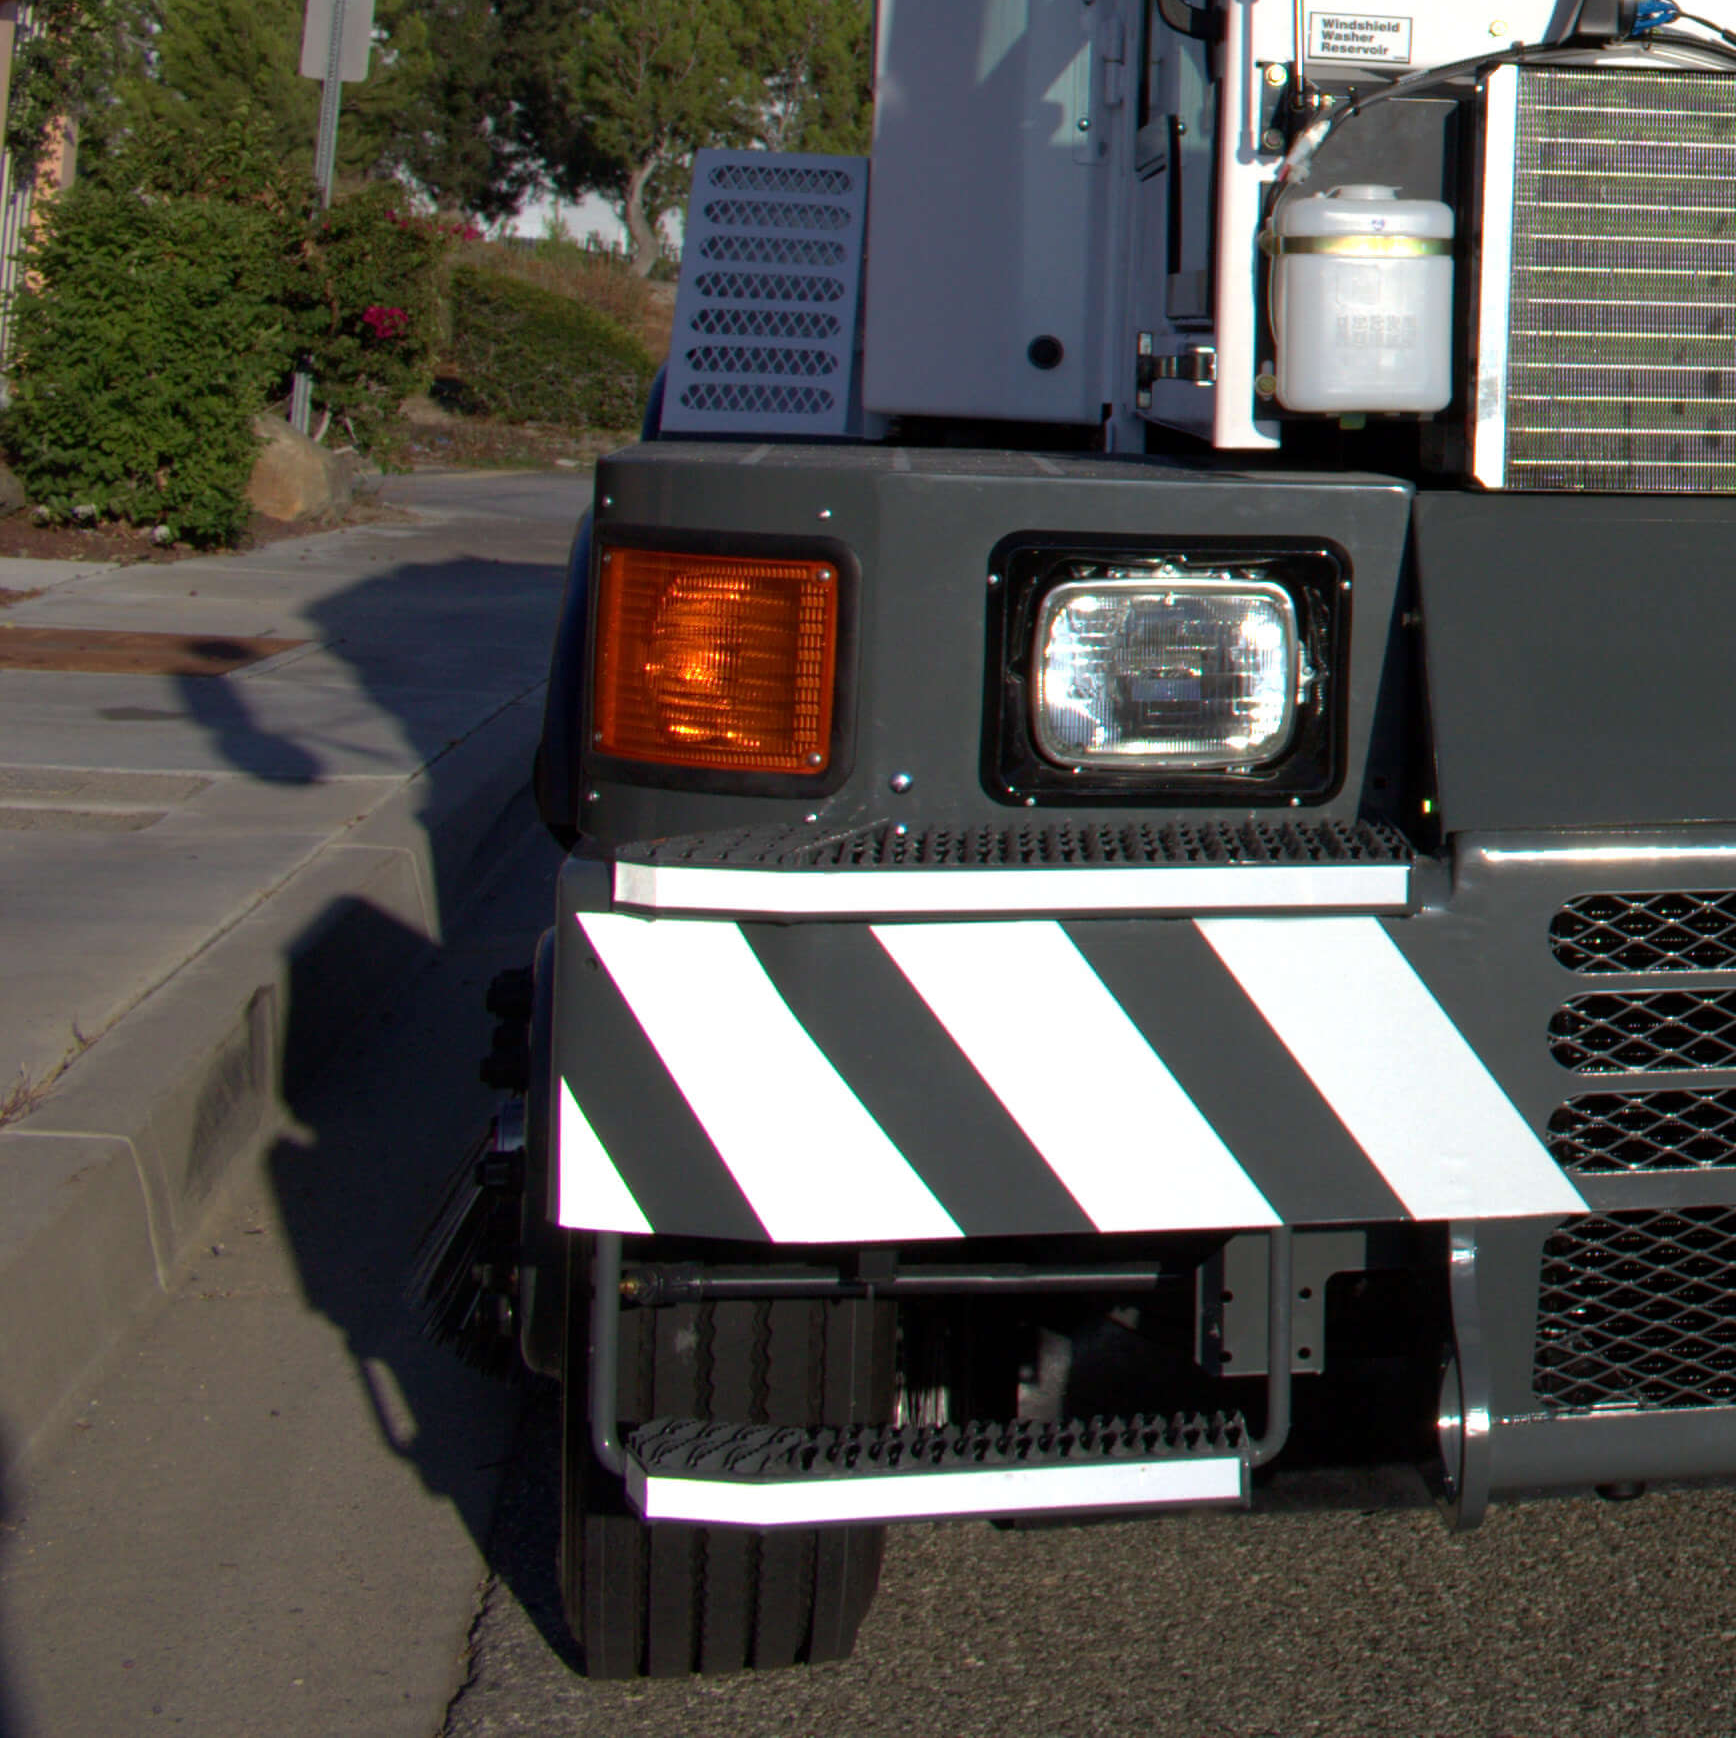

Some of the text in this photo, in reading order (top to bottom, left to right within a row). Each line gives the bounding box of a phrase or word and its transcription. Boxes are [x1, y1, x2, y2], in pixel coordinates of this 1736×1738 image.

[1321, 18, 1401, 33] Windshield
[1321, 29, 1375, 43] Washer
[1321, 41, 1390, 55] Reservoir
